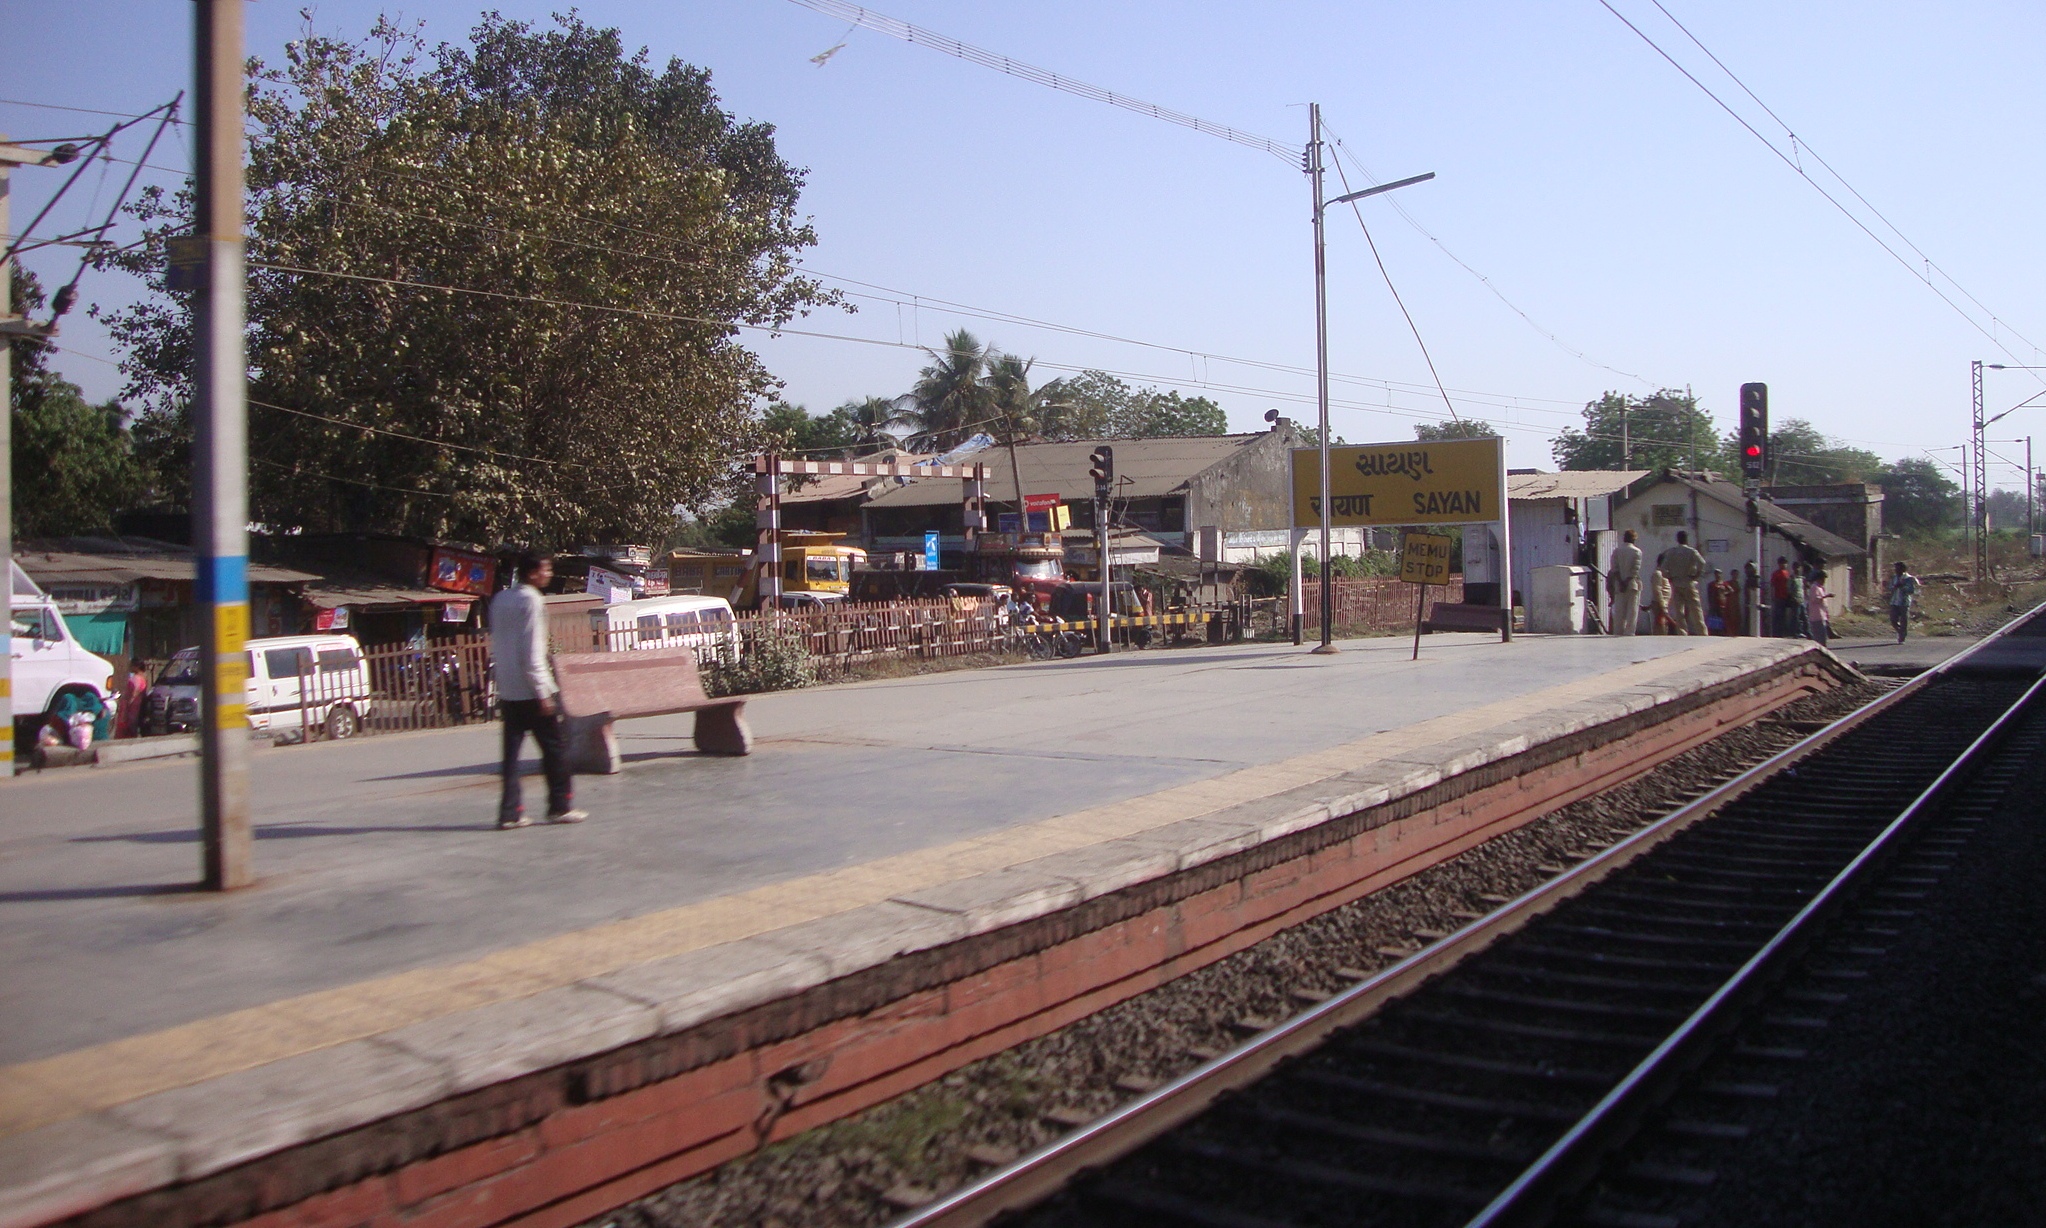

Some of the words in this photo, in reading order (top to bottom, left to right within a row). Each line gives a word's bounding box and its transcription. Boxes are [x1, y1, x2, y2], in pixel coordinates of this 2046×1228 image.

[1355, 451, 1433, 481] સાયણ
[1413, 490, 1480, 515] SAYAN
[1408, 542, 1446, 559] MEMU
[1405, 561, 1443, 578] STOP
